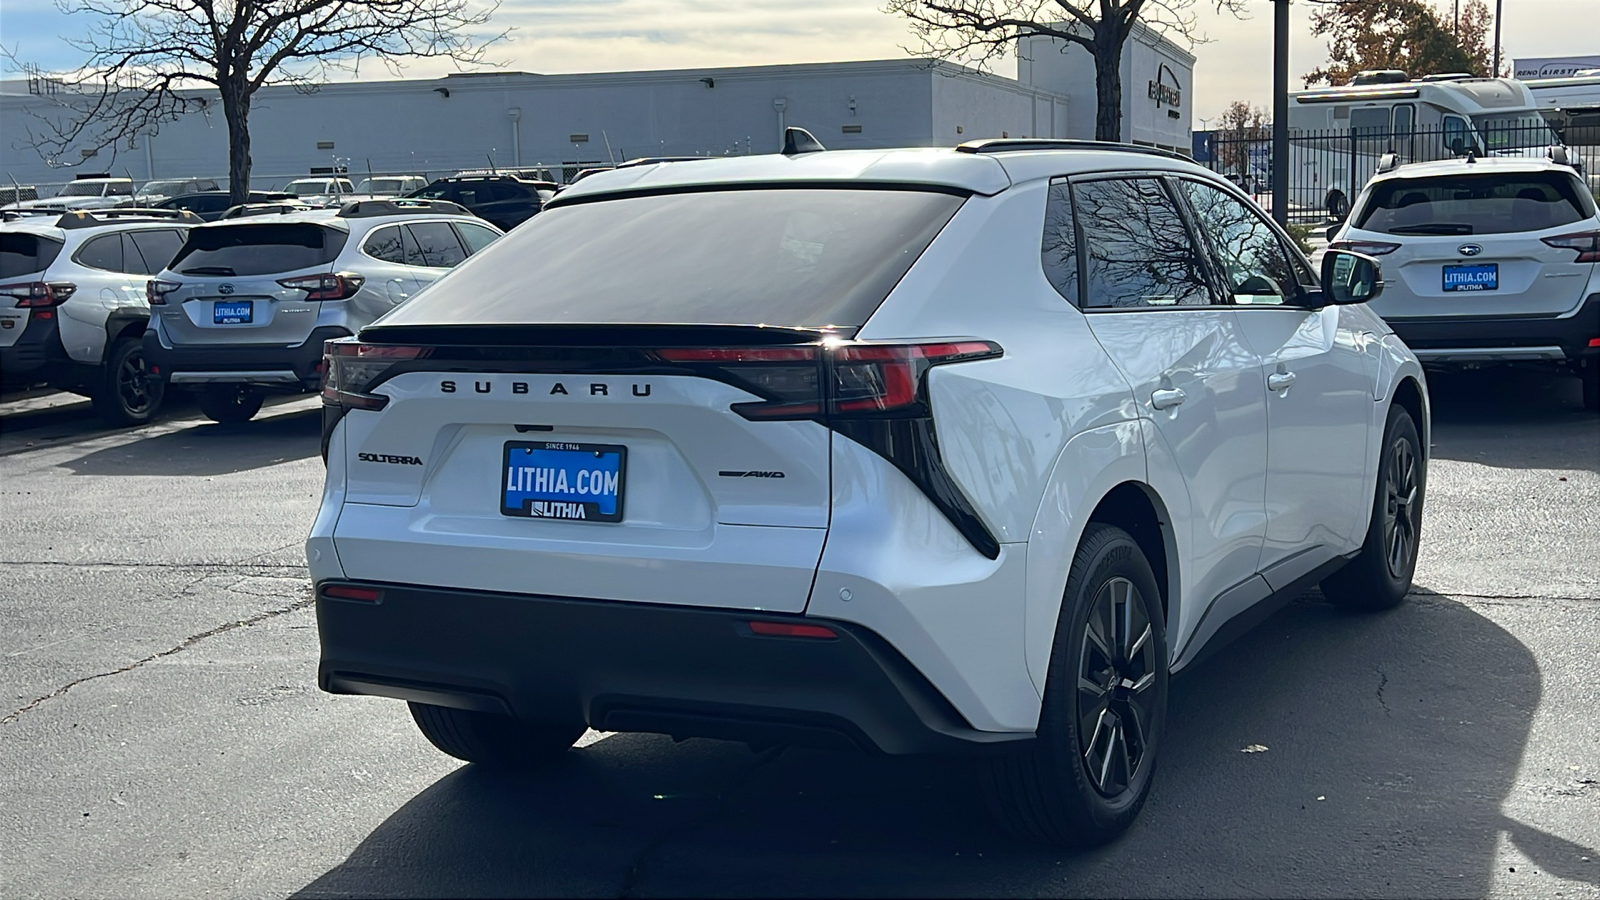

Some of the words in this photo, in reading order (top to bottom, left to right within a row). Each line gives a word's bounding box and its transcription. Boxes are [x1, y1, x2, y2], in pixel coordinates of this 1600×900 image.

[1542, 67, 1600, 76] AIRST
[1445, 272, 1496, 283] LITHIA.COM
[215, 307, 250, 317] LITHIA.COM
[440, 380, 651, 397] SUBARU
[545, 442, 564, 450] SINCE
[565, 443, 580, 451] 1946
[358, 452, 423, 466] SOLTERRA
[743, 470, 785, 479] AWD
[507, 466, 619, 497] LITHIA.COM
[543, 501, 586, 519] LITHIA
